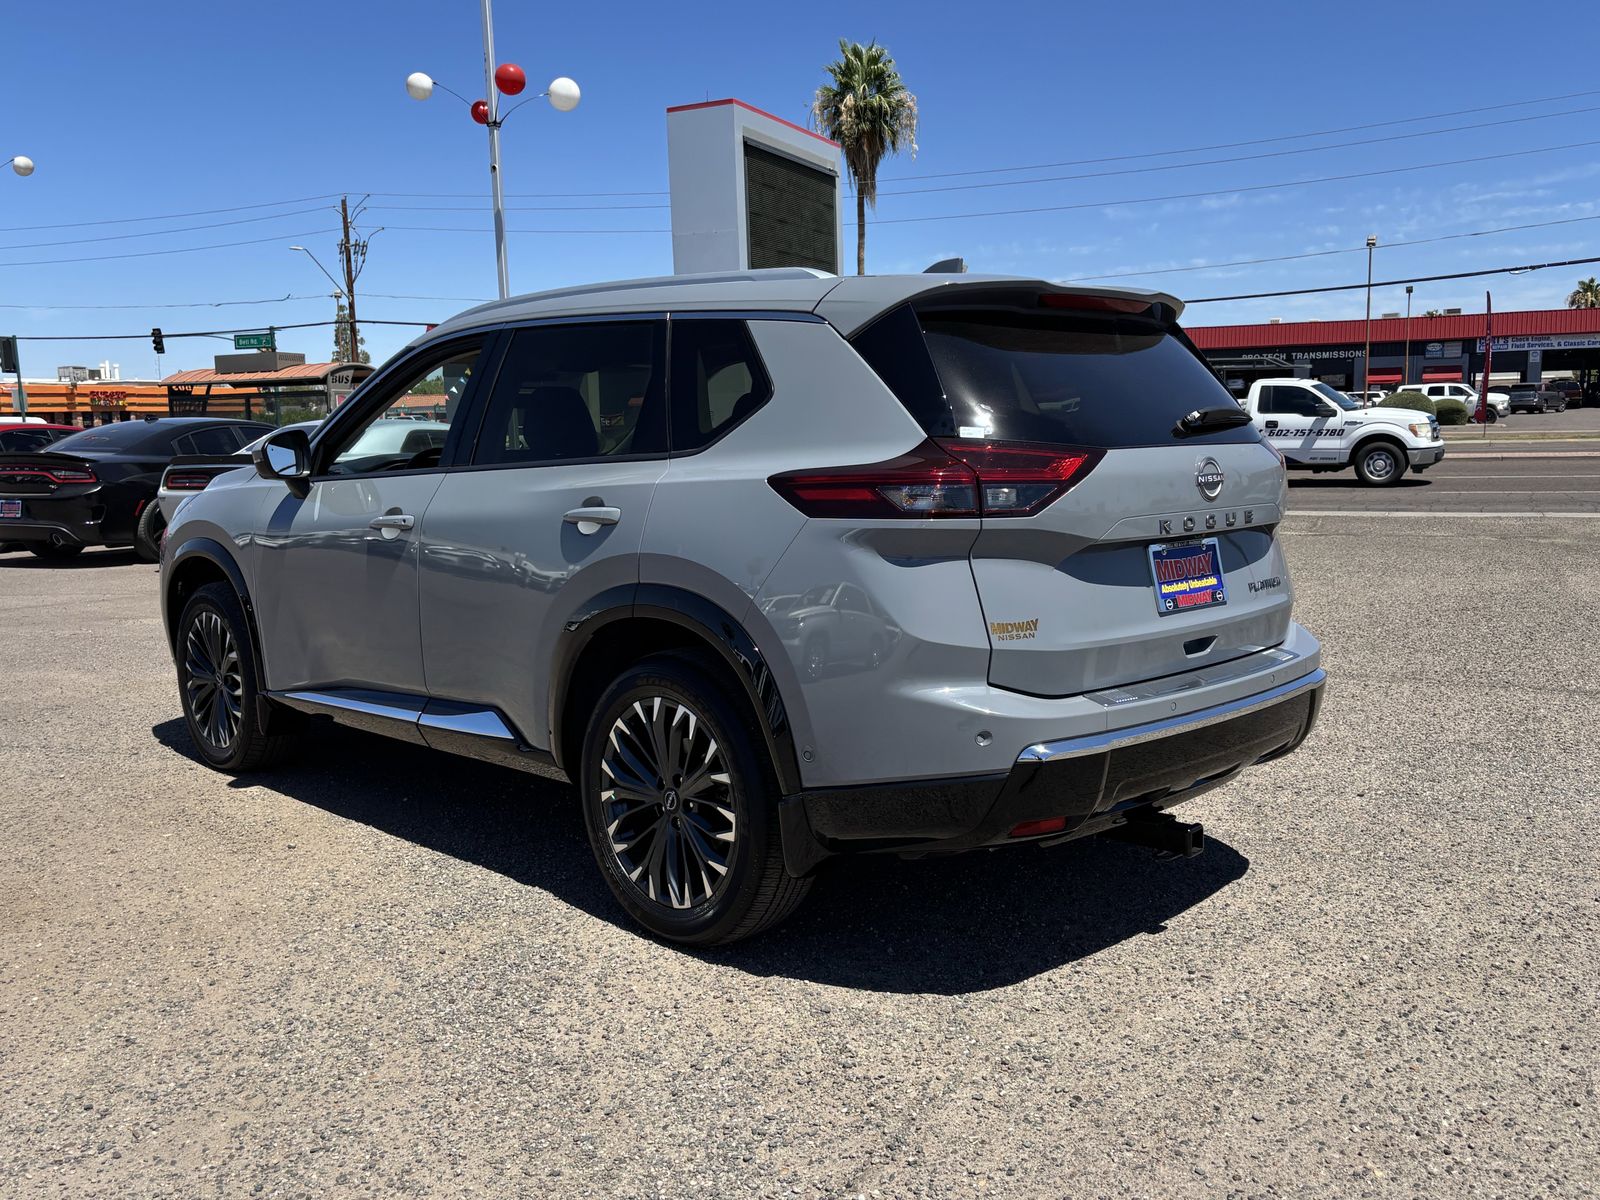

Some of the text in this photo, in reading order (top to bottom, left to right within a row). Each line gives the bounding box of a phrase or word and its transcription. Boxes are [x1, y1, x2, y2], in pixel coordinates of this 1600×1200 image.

[1291, 350, 1367, 360] TRANSMISSIONS
[331, 374, 351, 384] BUS
[1268, 429, 1346, 437] 602-757-6780
[1198, 474, 1225, 483] NISSAN
[1158, 509, 1255, 535] ROGUE
[1155, 551, 1213, 582] MIDWAY
[1161, 576, 1218, 593] Absolutely Unbeatable
[1176, 589, 1213, 608] MIDWAY
[990, 618, 1039, 635] MIDWAY
[997, 632, 1036, 642] NISSAN
